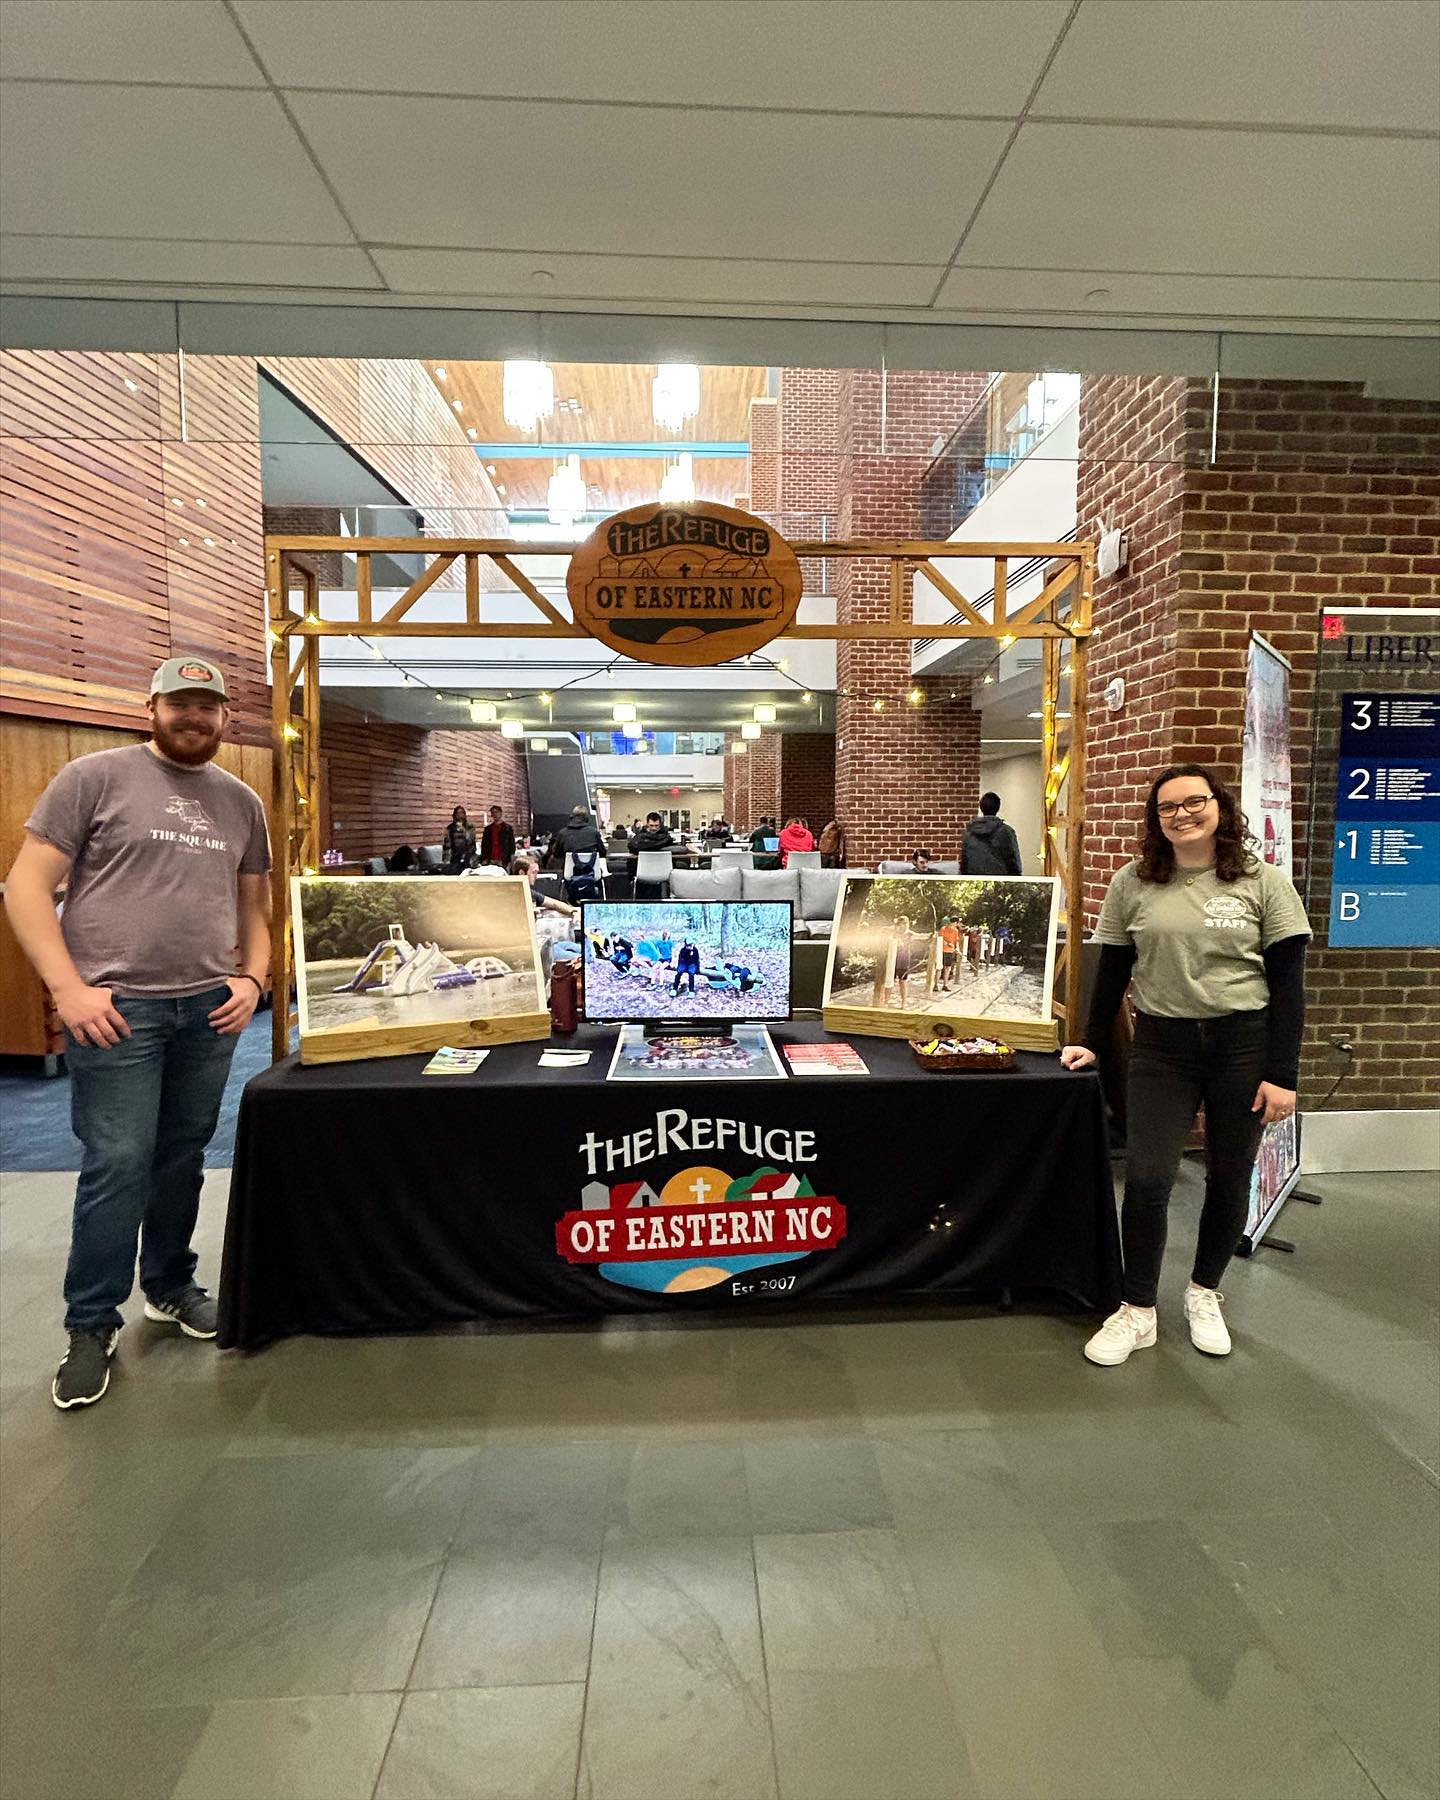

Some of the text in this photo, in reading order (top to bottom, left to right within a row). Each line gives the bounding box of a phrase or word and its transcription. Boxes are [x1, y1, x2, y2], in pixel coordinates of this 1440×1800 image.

[596, 586, 772, 609] OF EASTERN NC
[1345, 636, 1440, 664] LIBER
[1351, 701, 1373, 731] 3
[1348, 769, 1370, 800] 2
[150, 829, 177, 841] THE
[178, 833, 227, 852] SQUARE
[1346, 830, 1358, 860] 1
[1340, 892, 1360, 921] B
[1204, 918, 1247, 929] STAFF
[570, 1206, 832, 1253] OF EASTERN NC
[760, 1276, 796, 1291] 2007
